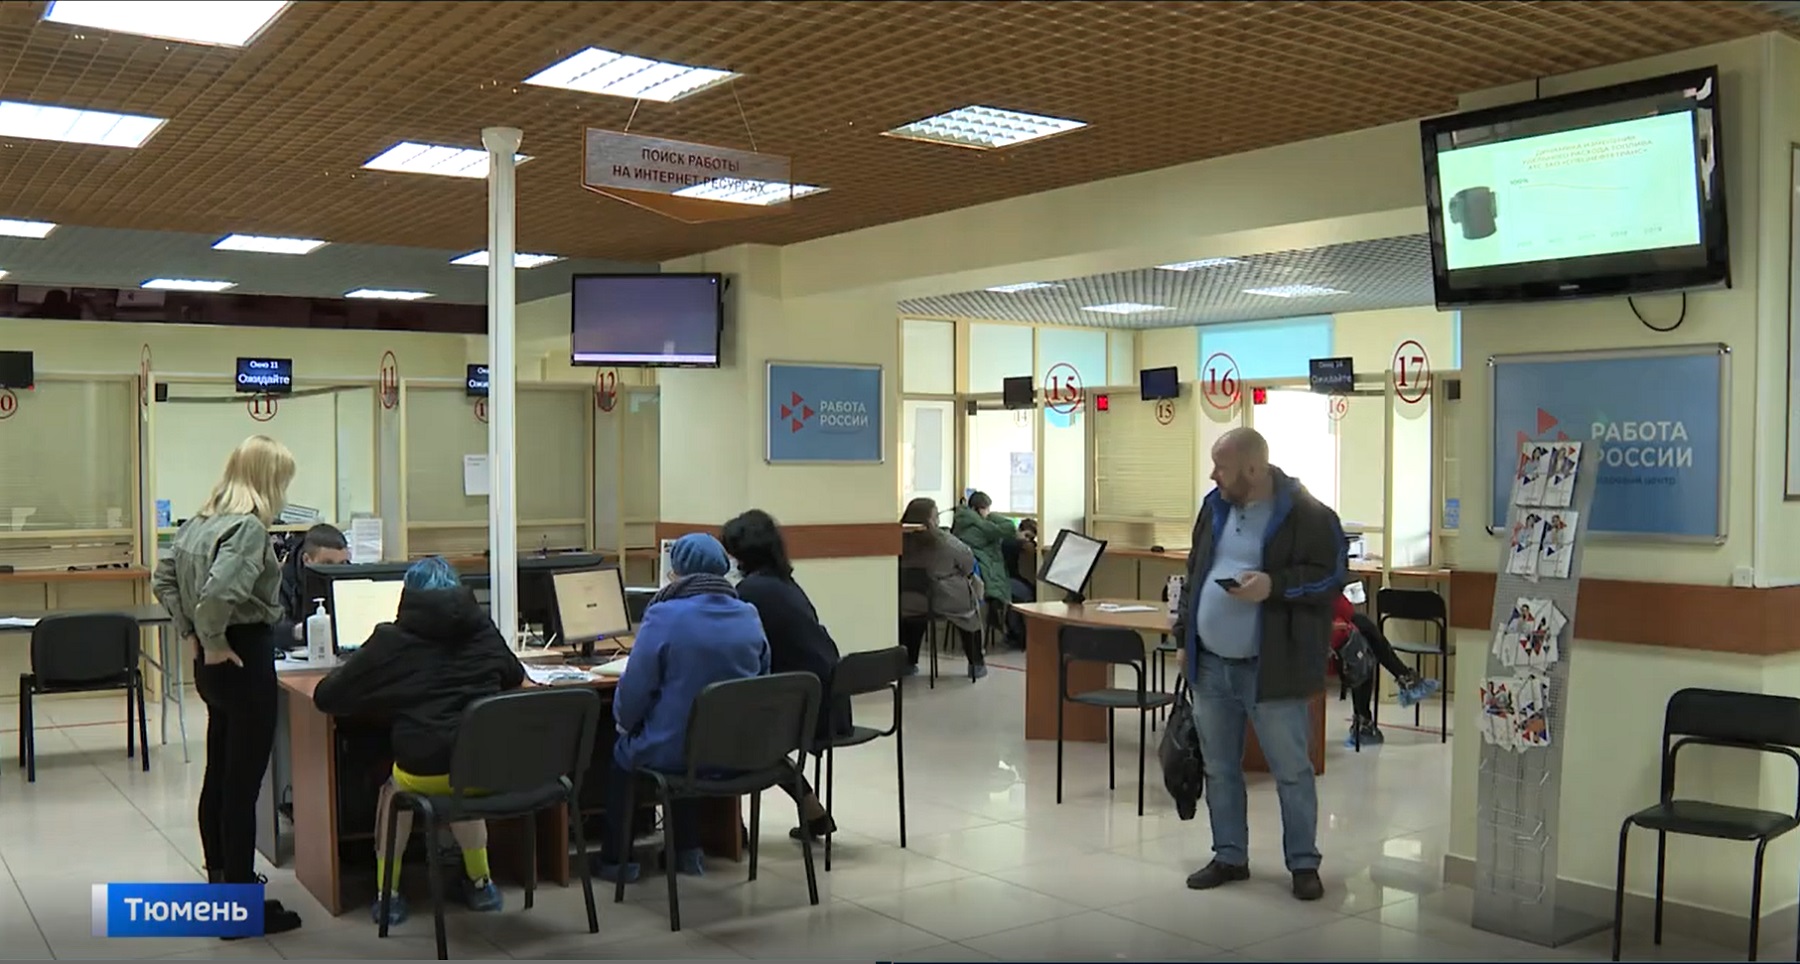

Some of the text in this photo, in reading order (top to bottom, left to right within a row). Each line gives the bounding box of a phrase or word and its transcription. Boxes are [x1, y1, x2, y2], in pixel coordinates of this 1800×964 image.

[641, 148, 740, 172] ПОИСК РАБОТЫ
[612, 165, 767, 194] НА ИНТЕРНЕТ-РЕСУРСАХ
[270, 361, 279, 369] 11
[1398, 356, 1425, 388] 17
[238, 373, 290, 386] Ожидайте
[382, 366, 395, 395] 11
[599, 371, 616, 398] 12
[1051, 375, 1078, 402] 15
[1208, 367, 1236, 397] 16
[253, 398, 272, 415] 11
[820, 400, 867, 413] РАБОТА
[1158, 404, 1172, 418] 15
[1329, 398, 1346, 414] 16
[820, 414, 869, 428] РОССИИ
[1591, 421, 1688, 442] РАБОТА
